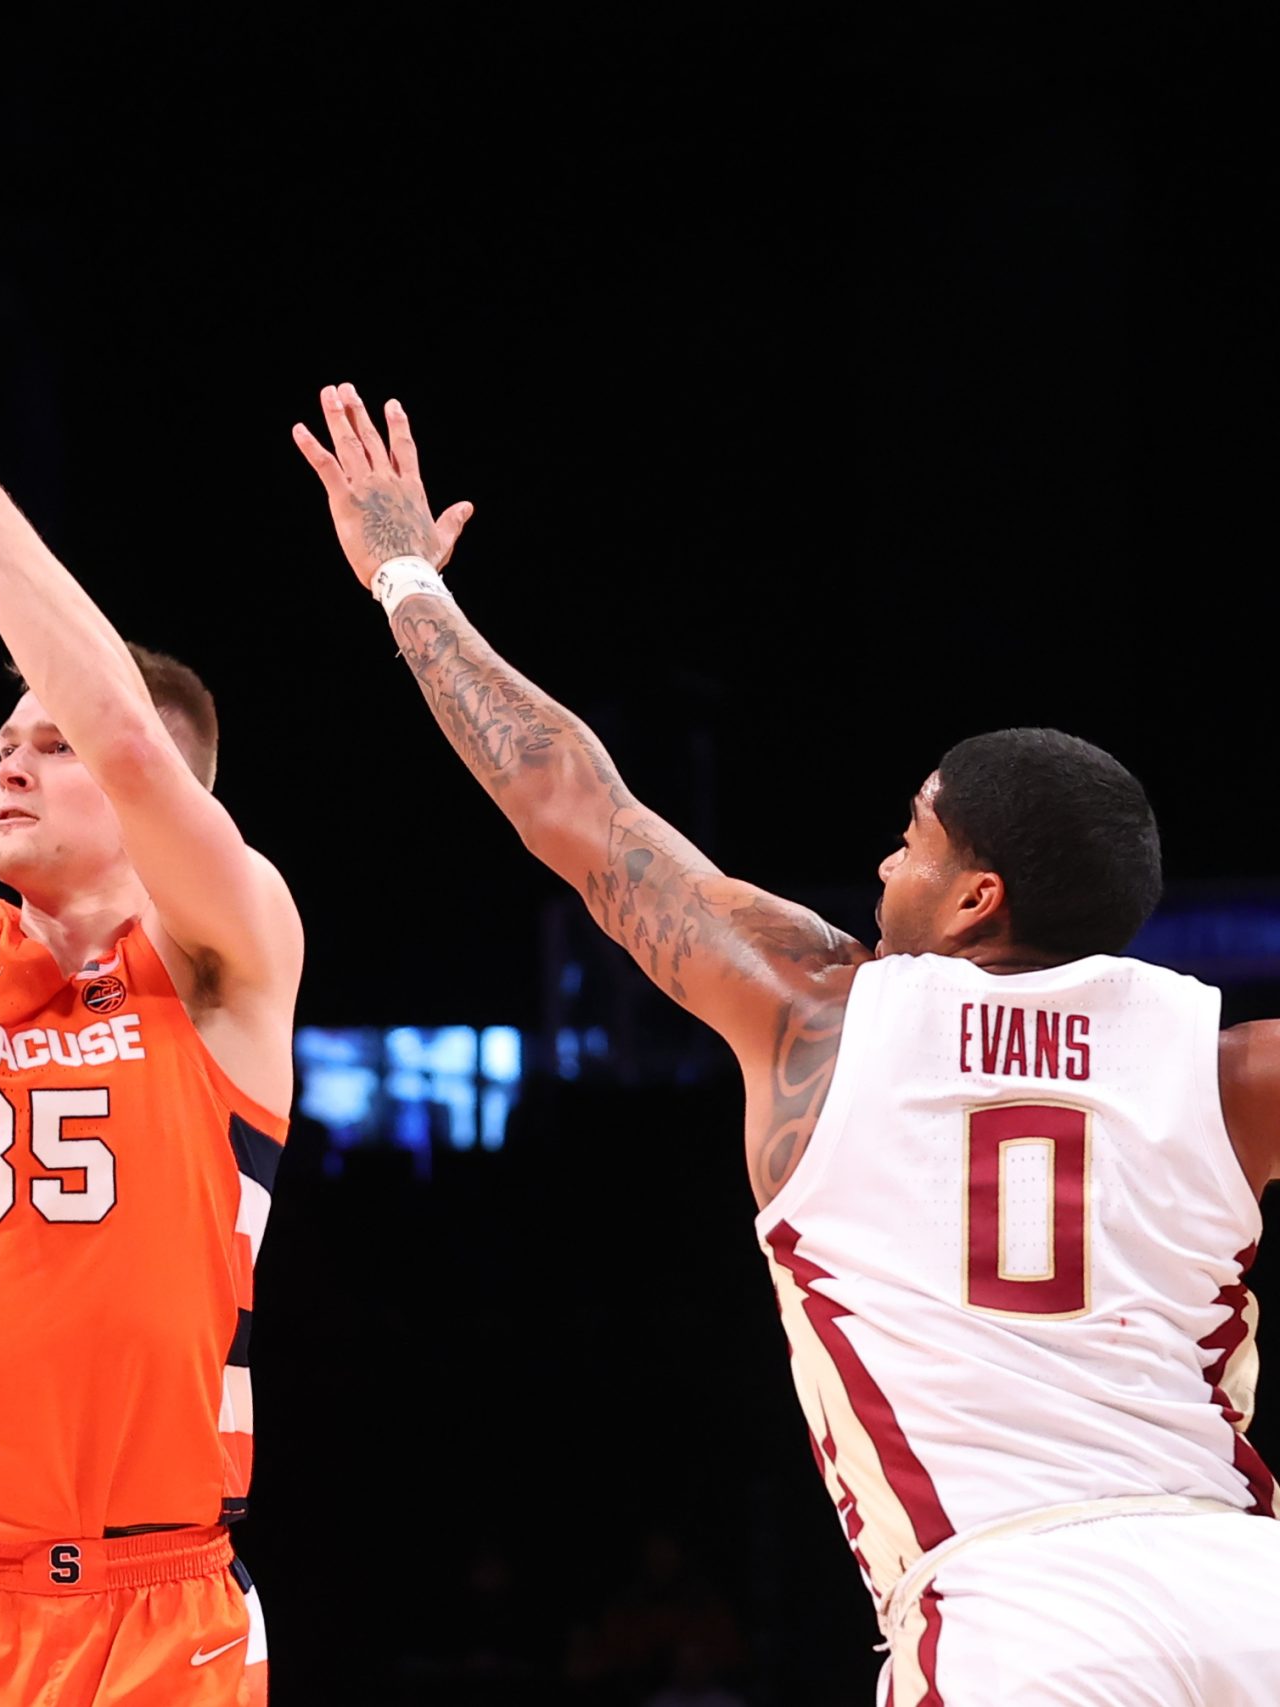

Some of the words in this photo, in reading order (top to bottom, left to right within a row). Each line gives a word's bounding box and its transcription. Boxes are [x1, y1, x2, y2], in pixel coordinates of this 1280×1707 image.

[960, 1003, 1091, 1081] EVANS
[961, 1100, 1093, 1321] 0
[49, 1543, 81, 1585] S
